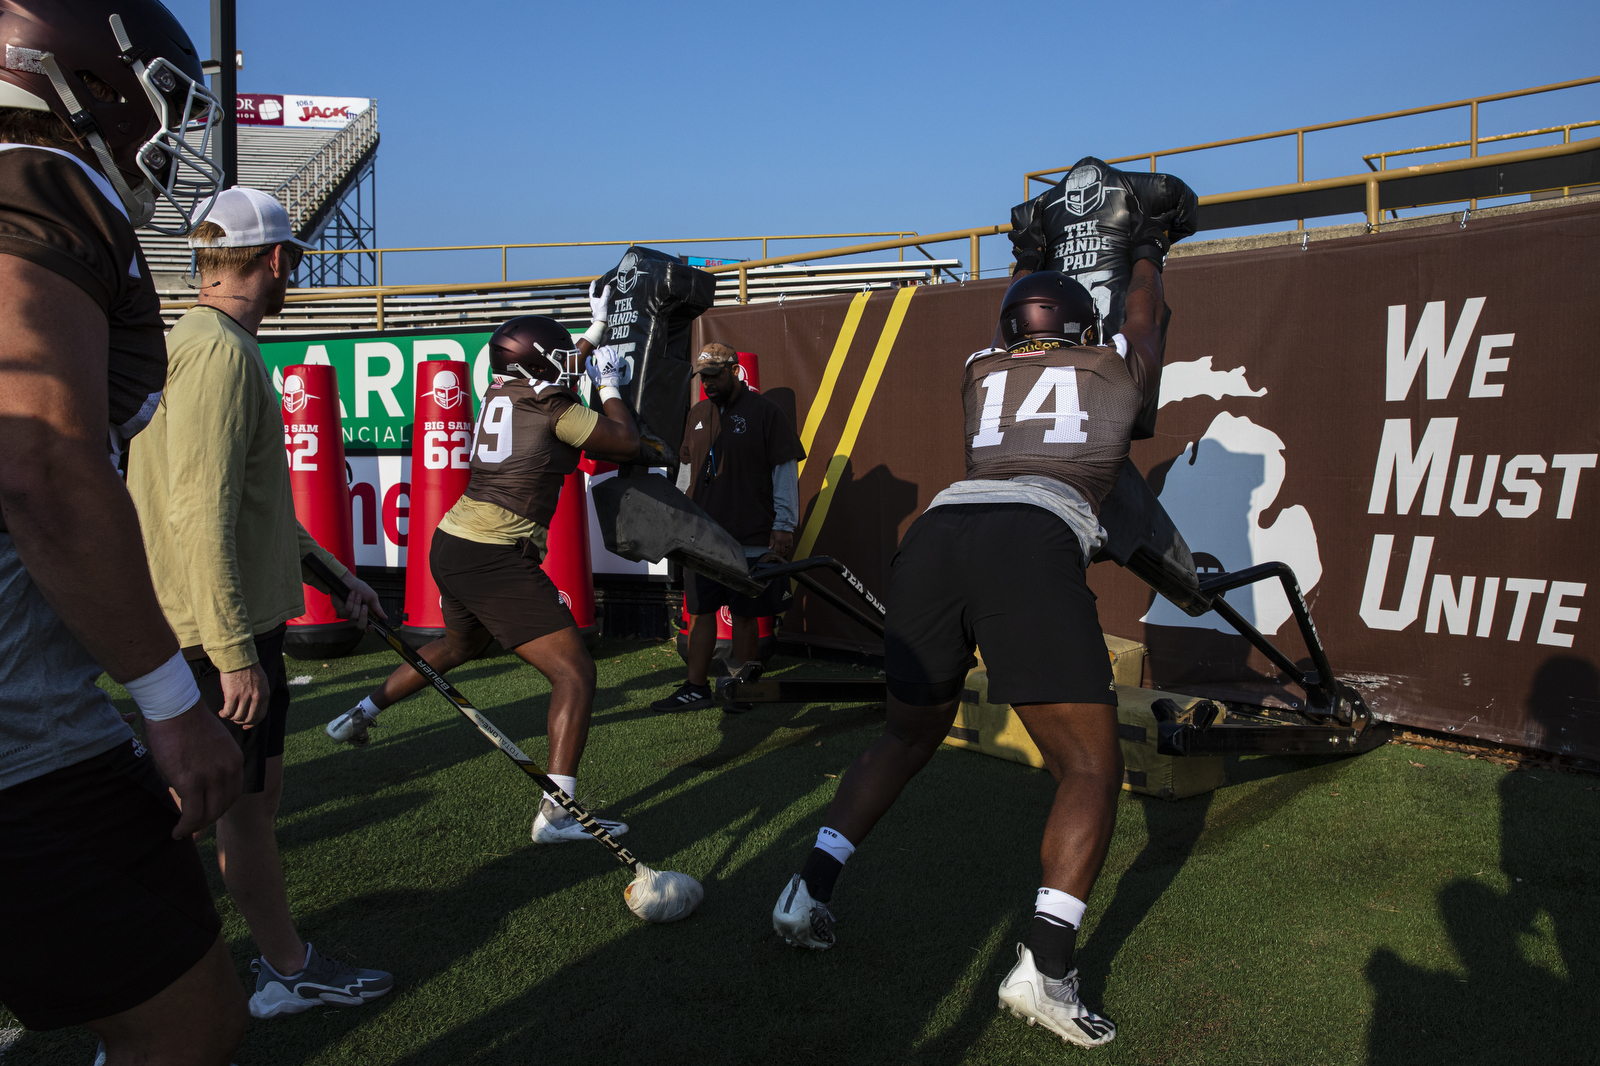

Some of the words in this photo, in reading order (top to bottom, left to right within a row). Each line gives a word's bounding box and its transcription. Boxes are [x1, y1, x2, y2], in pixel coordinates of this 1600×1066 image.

[298, 106, 350, 122] JACK
[1054, 236, 1113, 259] HANDS
[1062, 251, 1098, 272] PAD
[607, 310, 639, 328] HANDS
[610, 325, 630, 340] PAD
[1385, 296, 1516, 402] WE
[971, 366, 1089, 448] 14
[291, 424, 319, 433] SAM
[424, 421, 445, 431] BIG
[448, 421, 471, 431] SAM
[285, 433, 319, 471] 2
[423, 430, 472, 469] 62
[1367, 416, 1599, 520] MUST
[1358, 533, 1587, 648] UNITE
